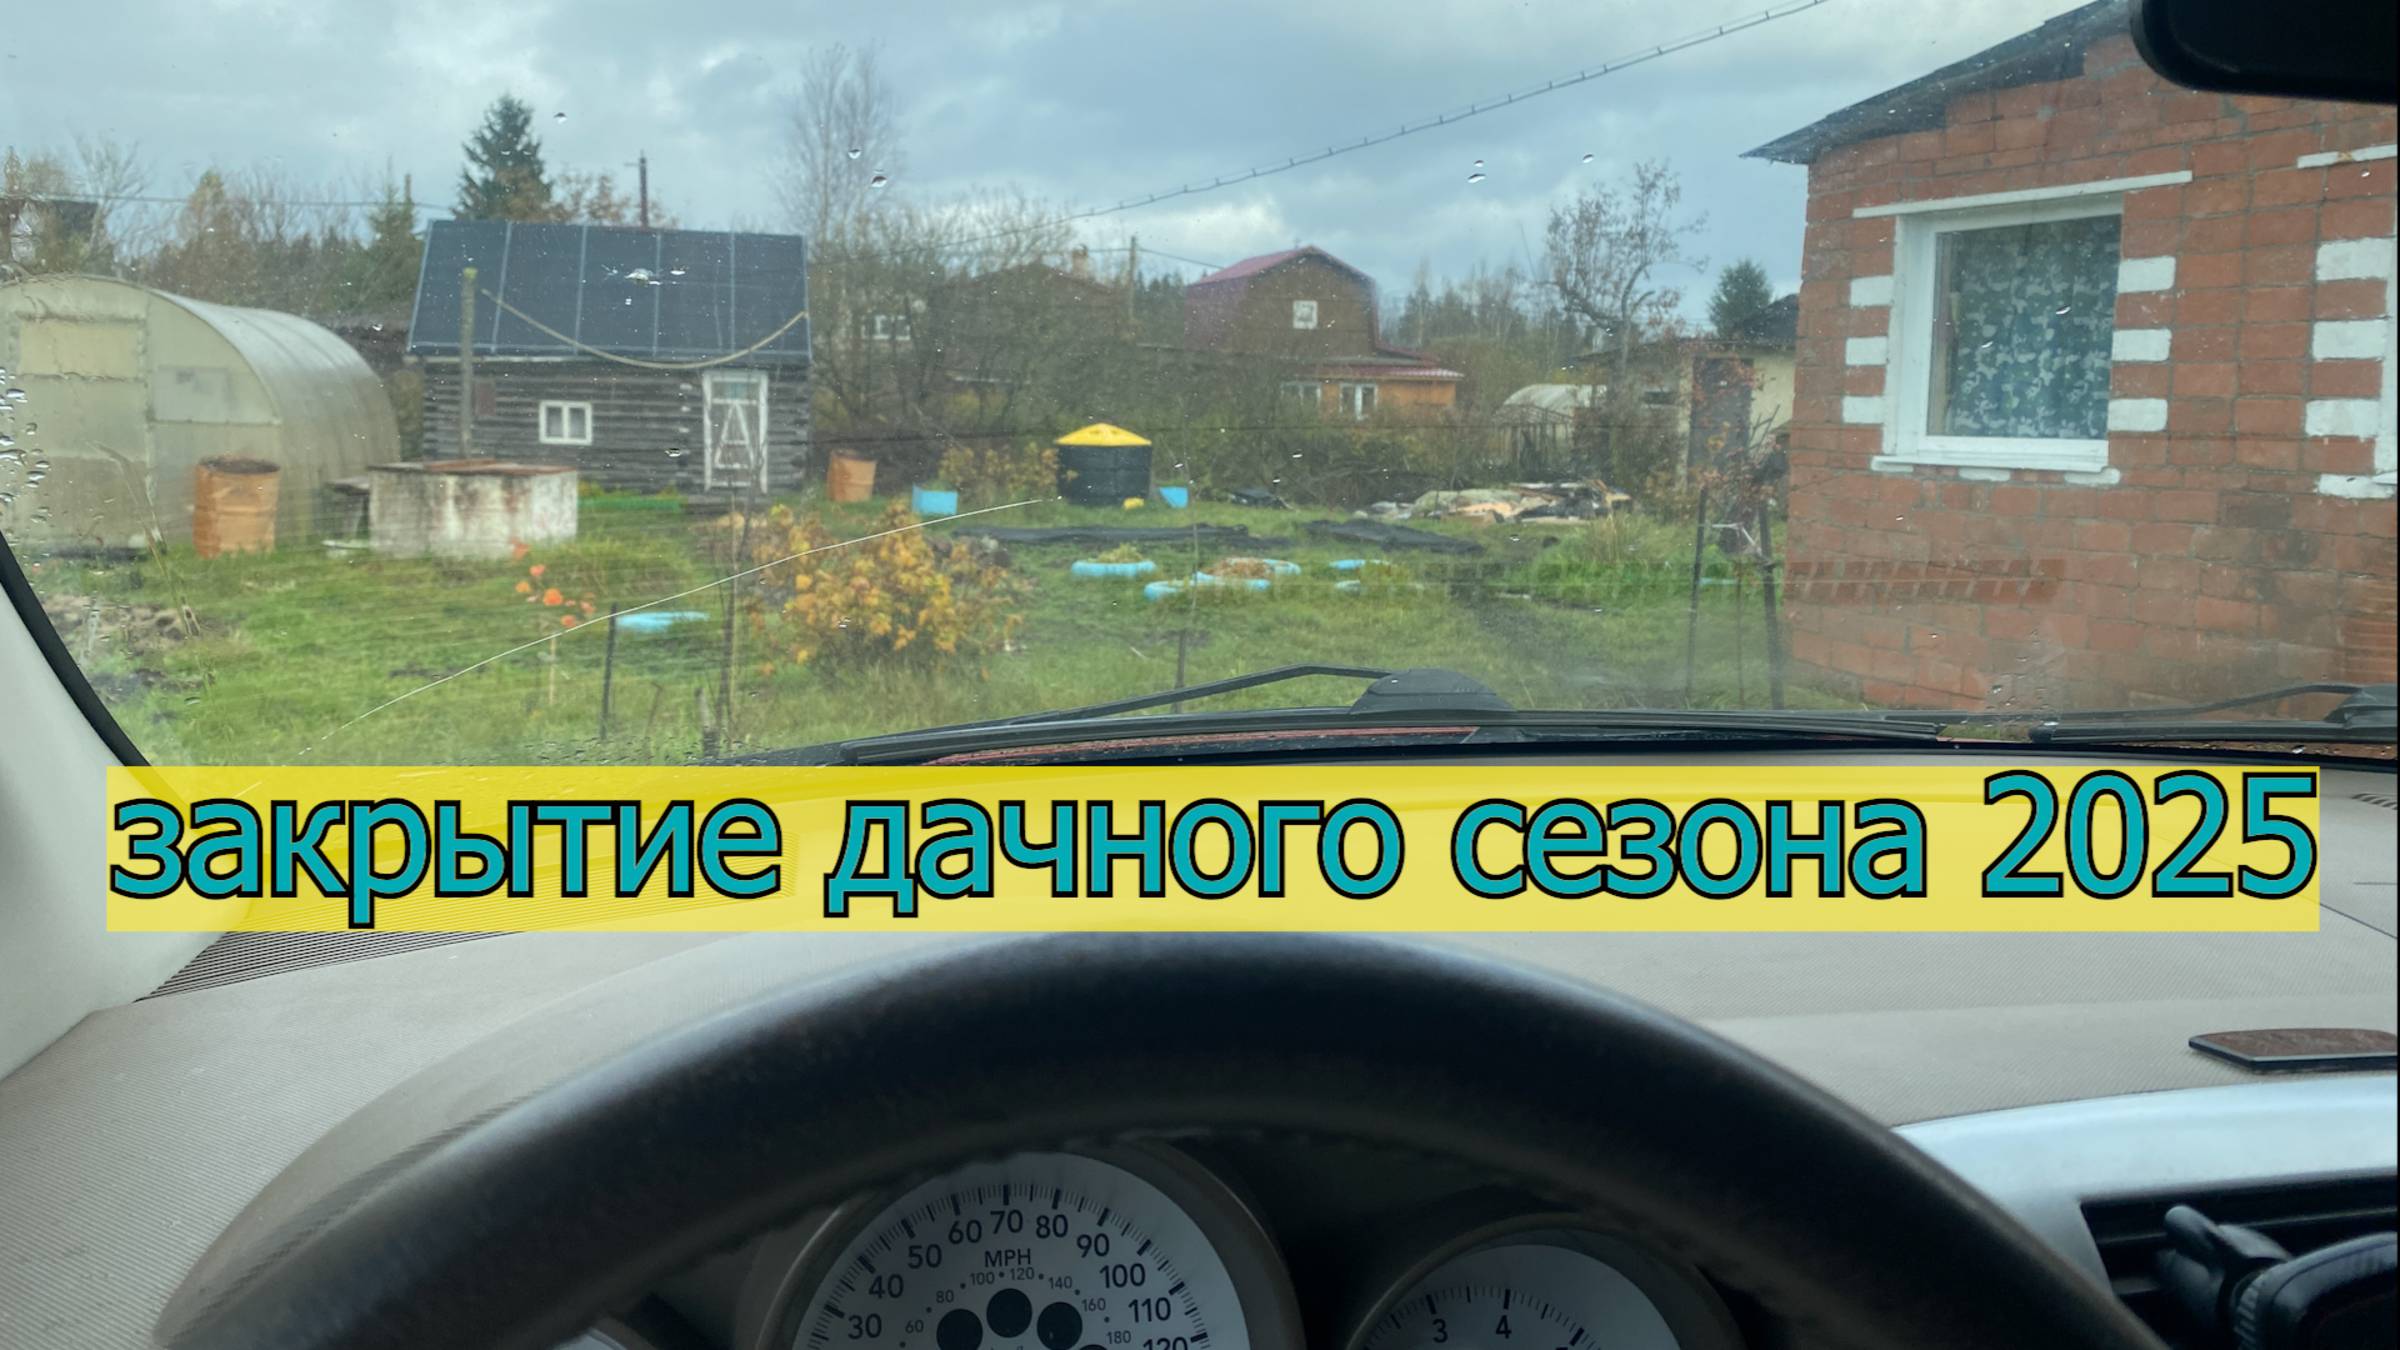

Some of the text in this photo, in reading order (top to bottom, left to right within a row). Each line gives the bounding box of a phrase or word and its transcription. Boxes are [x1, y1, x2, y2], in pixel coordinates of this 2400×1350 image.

[947, 1219, 983, 1245] 60
[989, 1209, 1024, 1235] 70
[1035, 1214, 1069, 1239] 80
[907, 1243, 942, 1269] 50
[984, 1247, 1031, 1268] MPH
[1076, 1232, 1110, 1259] 90
[868, 1273, 904, 1299] 40
[969, 1271, 996, 1286] 100
[1009, 1266, 1035, 1281] 120
[1048, 1275, 1073, 1289] 140
[1099, 1262, 1146, 1289] 100
[935, 1289, 954, 1304] 80
[1081, 1297, 1106, 1312] 160
[1128, 1296, 1172, 1323] 110
[847, 1313, 882, 1340] 30
[904, 1319, 925, 1334] 60
[1107, 1330, 1132, 1345] 180
[1431, 1318, 1449, 1344] 3
[1495, 1314, 1512, 1340] 4
